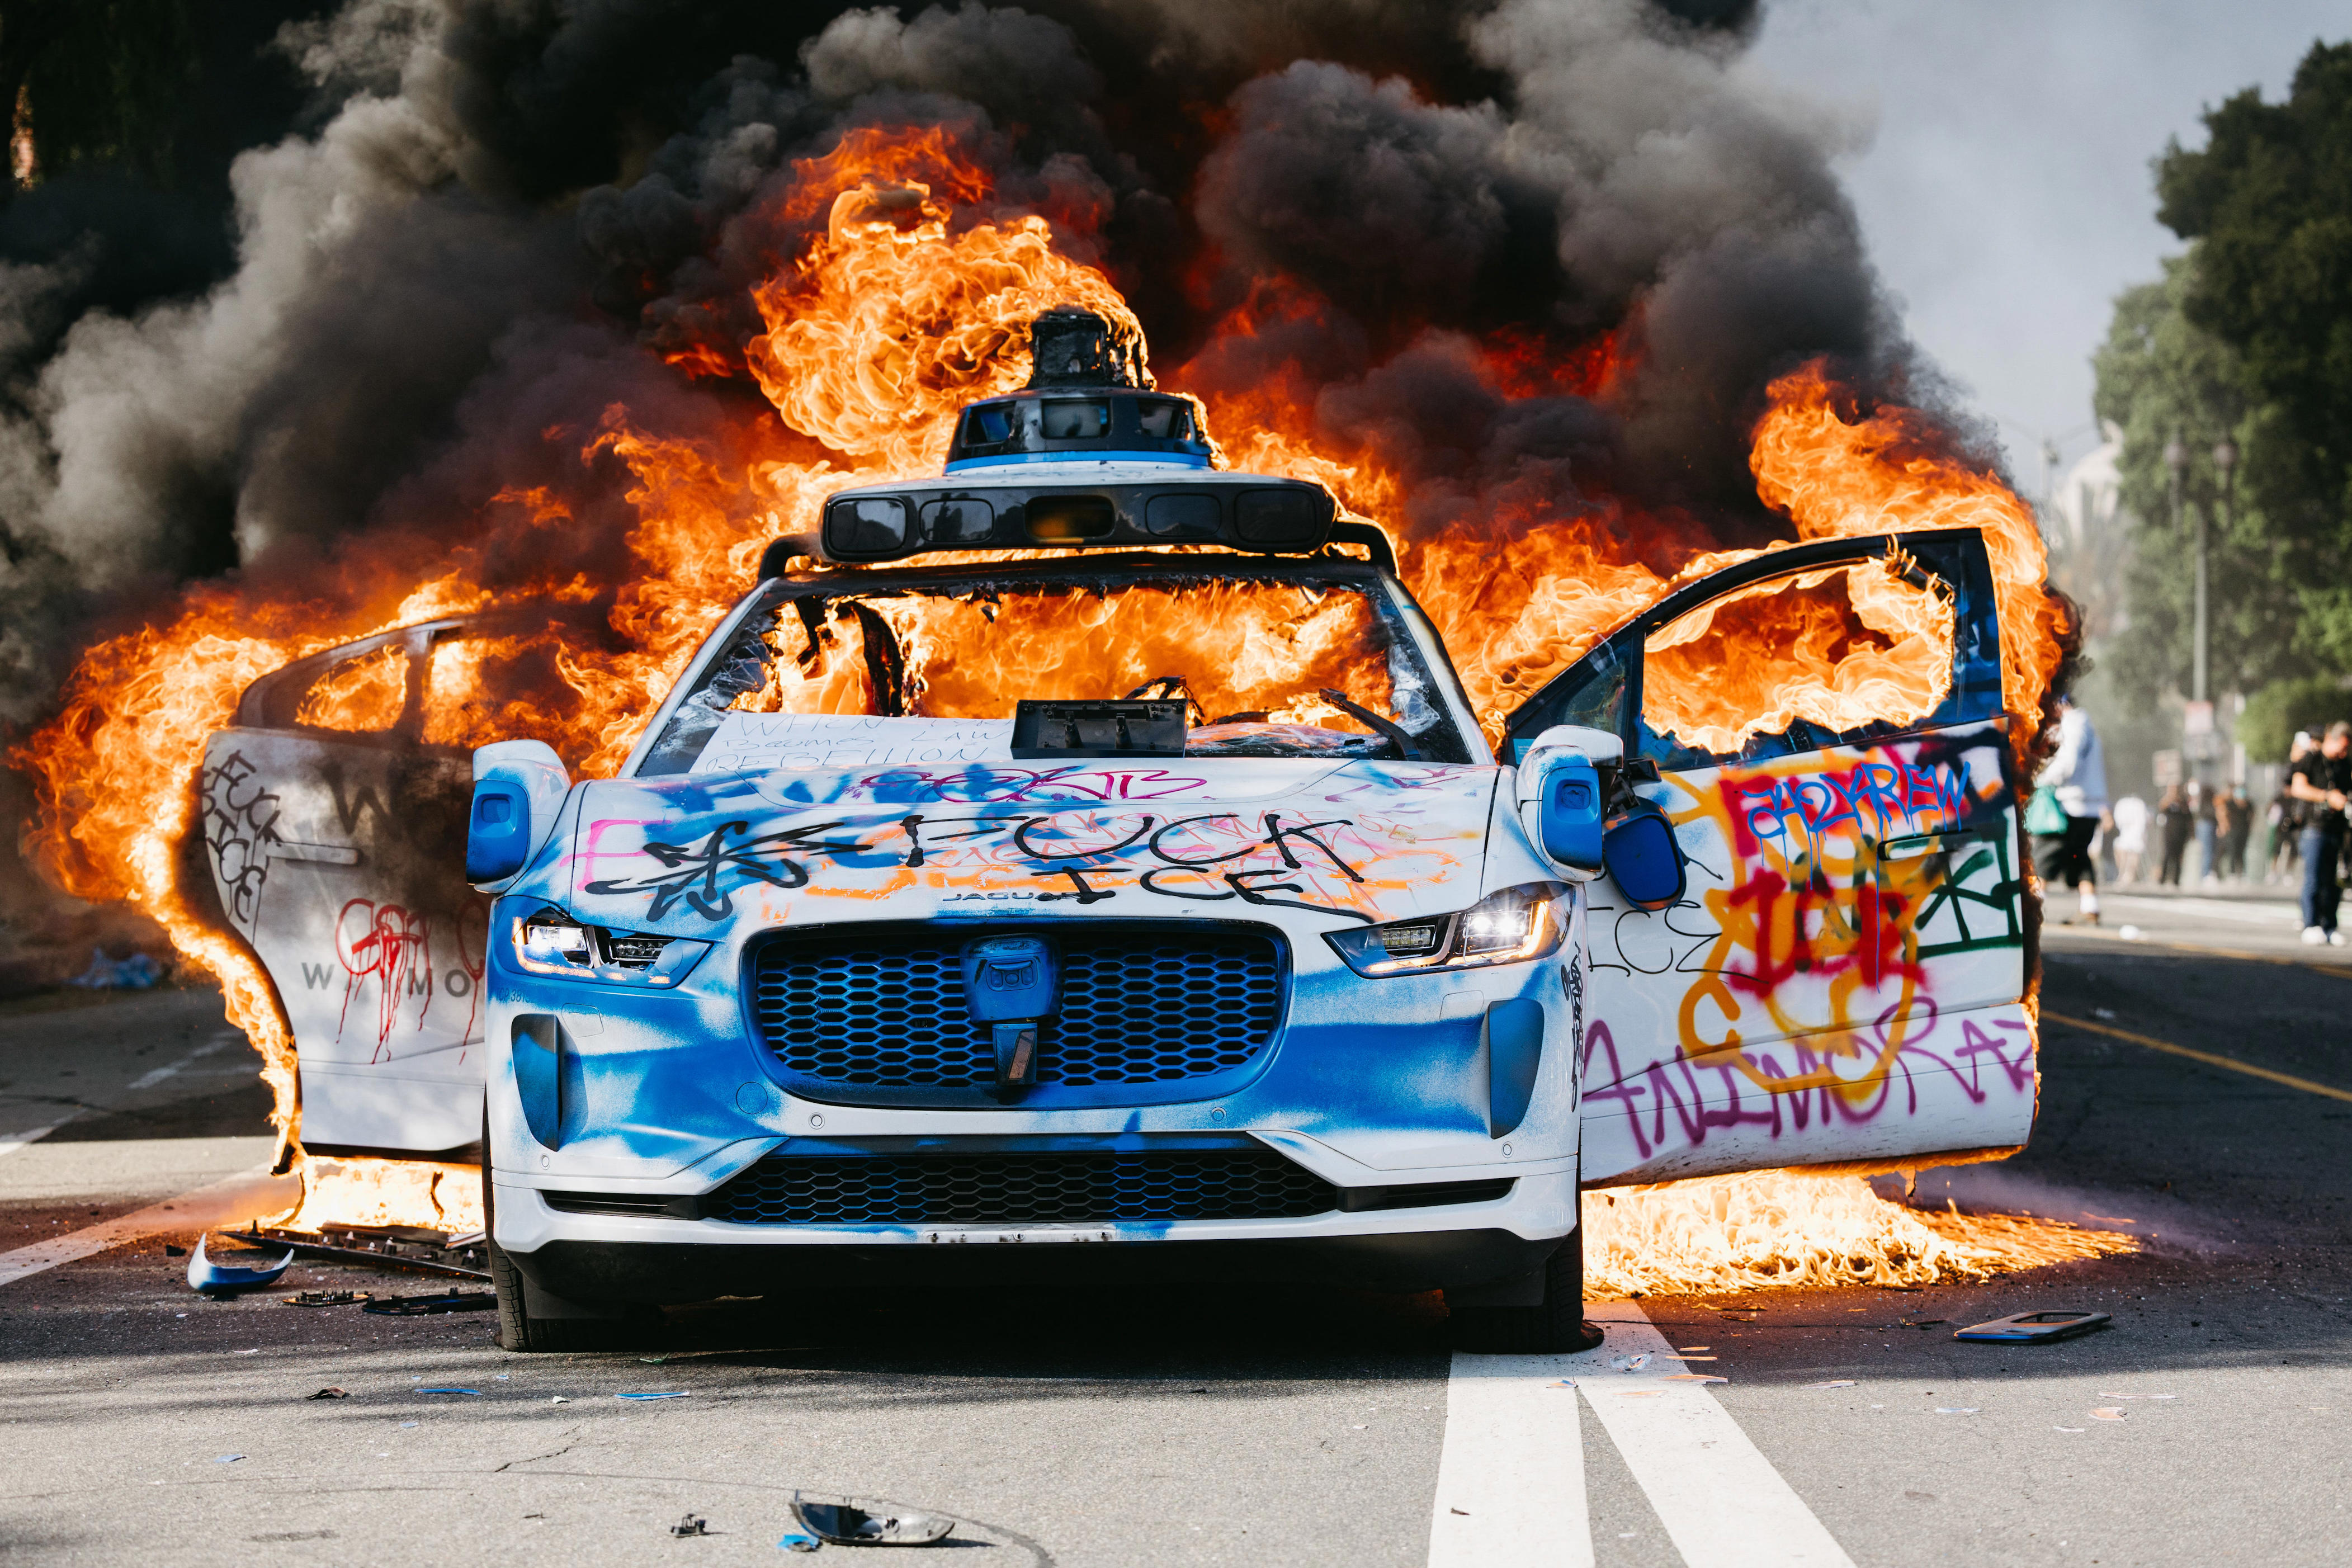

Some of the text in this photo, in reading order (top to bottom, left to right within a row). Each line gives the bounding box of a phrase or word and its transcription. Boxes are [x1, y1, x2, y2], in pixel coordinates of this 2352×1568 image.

[741, 715, 885, 736] WHEN
[911, 730, 1010, 742] LAW
[900, 814, 1365, 884] FUCK
[1031, 865, 1376, 924] ICE
[302, 962, 471, 998] WMO
